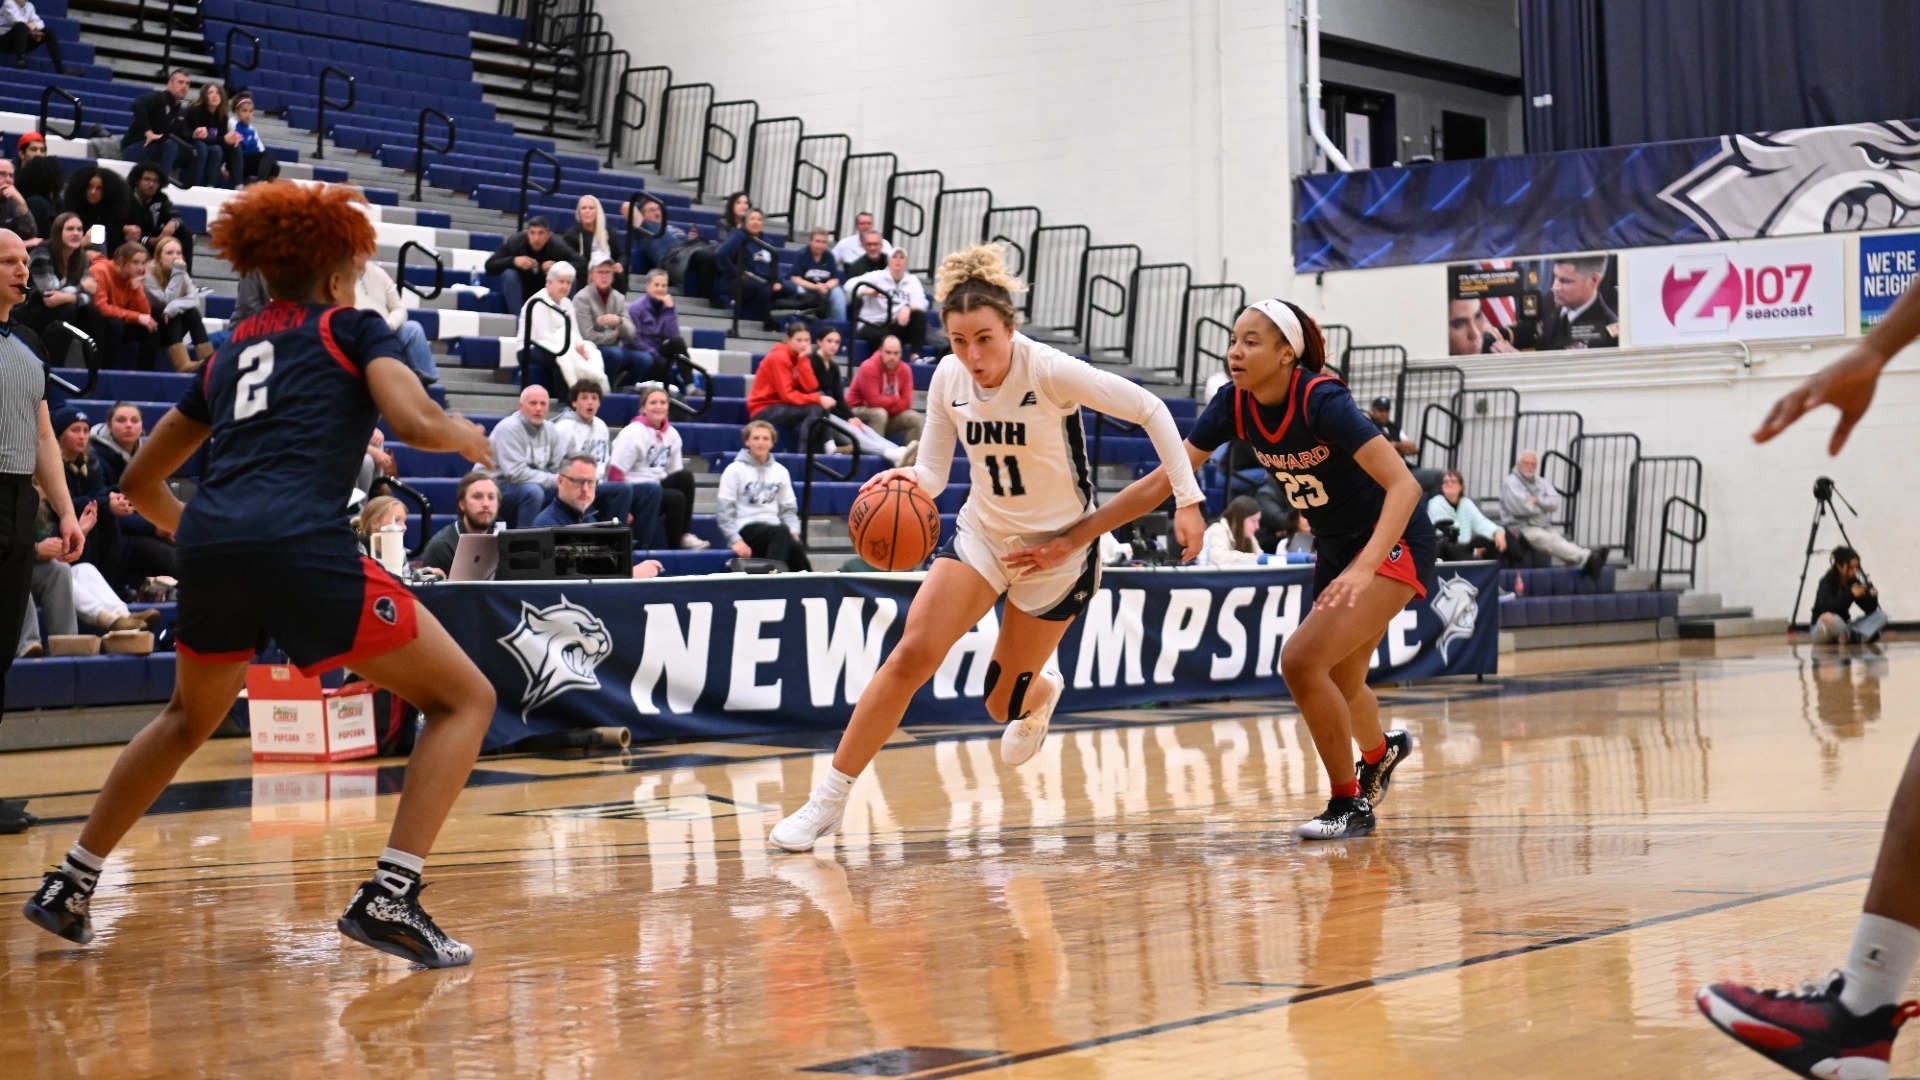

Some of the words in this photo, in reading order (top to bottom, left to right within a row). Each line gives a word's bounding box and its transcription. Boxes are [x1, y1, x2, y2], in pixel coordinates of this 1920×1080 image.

[1866, 250, 1917, 274] WE'RE
[1745, 305, 1814, 320] seacoast
[234, 340, 274, 421] 2
[966, 421, 1027, 446] UNH
[1252, 446, 1330, 470] OWARD
[985, 455, 1026, 496] 11
[1275, 471, 1329, 509] 23
[630, 597, 898, 715] NEW
[933, 584, 1422, 699] HMPSHE
